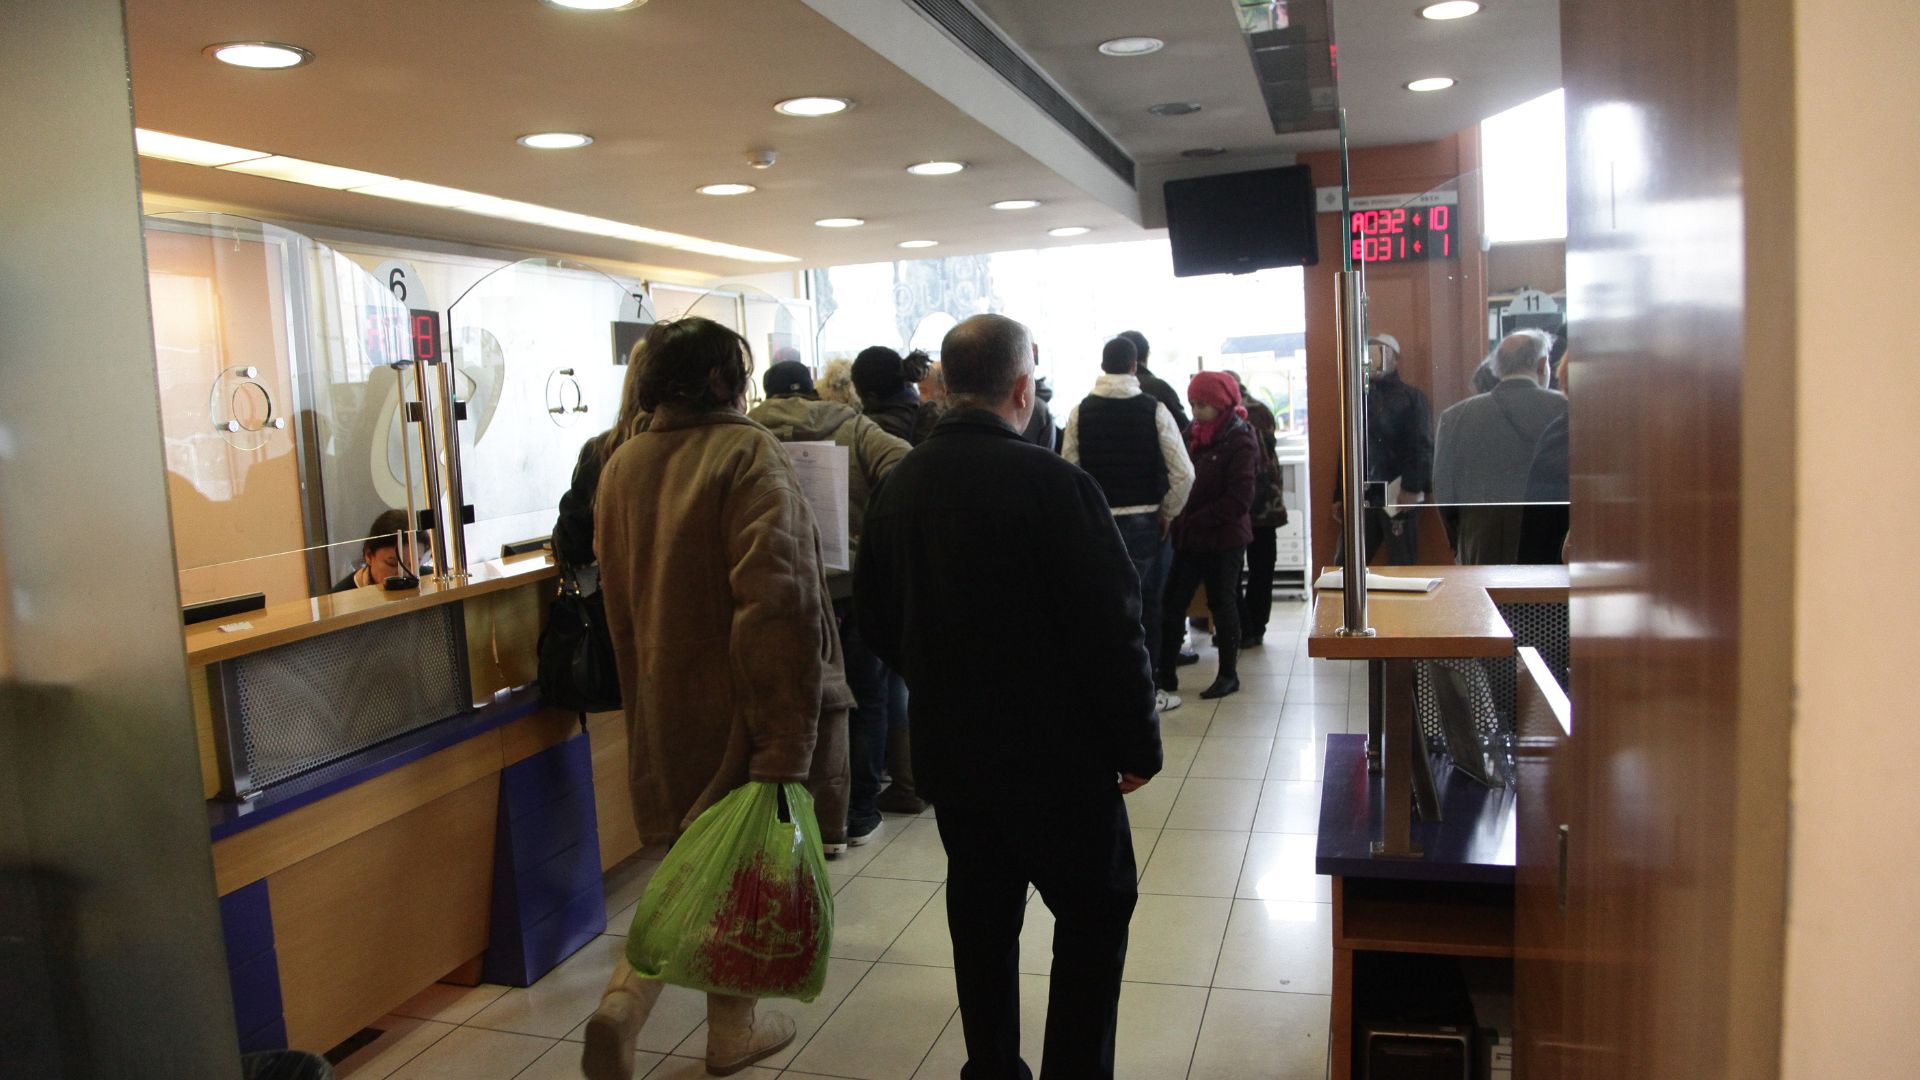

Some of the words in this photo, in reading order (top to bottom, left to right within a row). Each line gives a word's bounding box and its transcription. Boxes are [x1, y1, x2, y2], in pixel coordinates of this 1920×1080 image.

[1351, 208, 1405, 235] A032
[1430, 206, 1448, 231] 10
[1444, 234, 1449, 257] 1
[389, 268, 407, 302] 6
[632, 293, 643, 318] 7
[1523, 295, 1540, 312] 11
